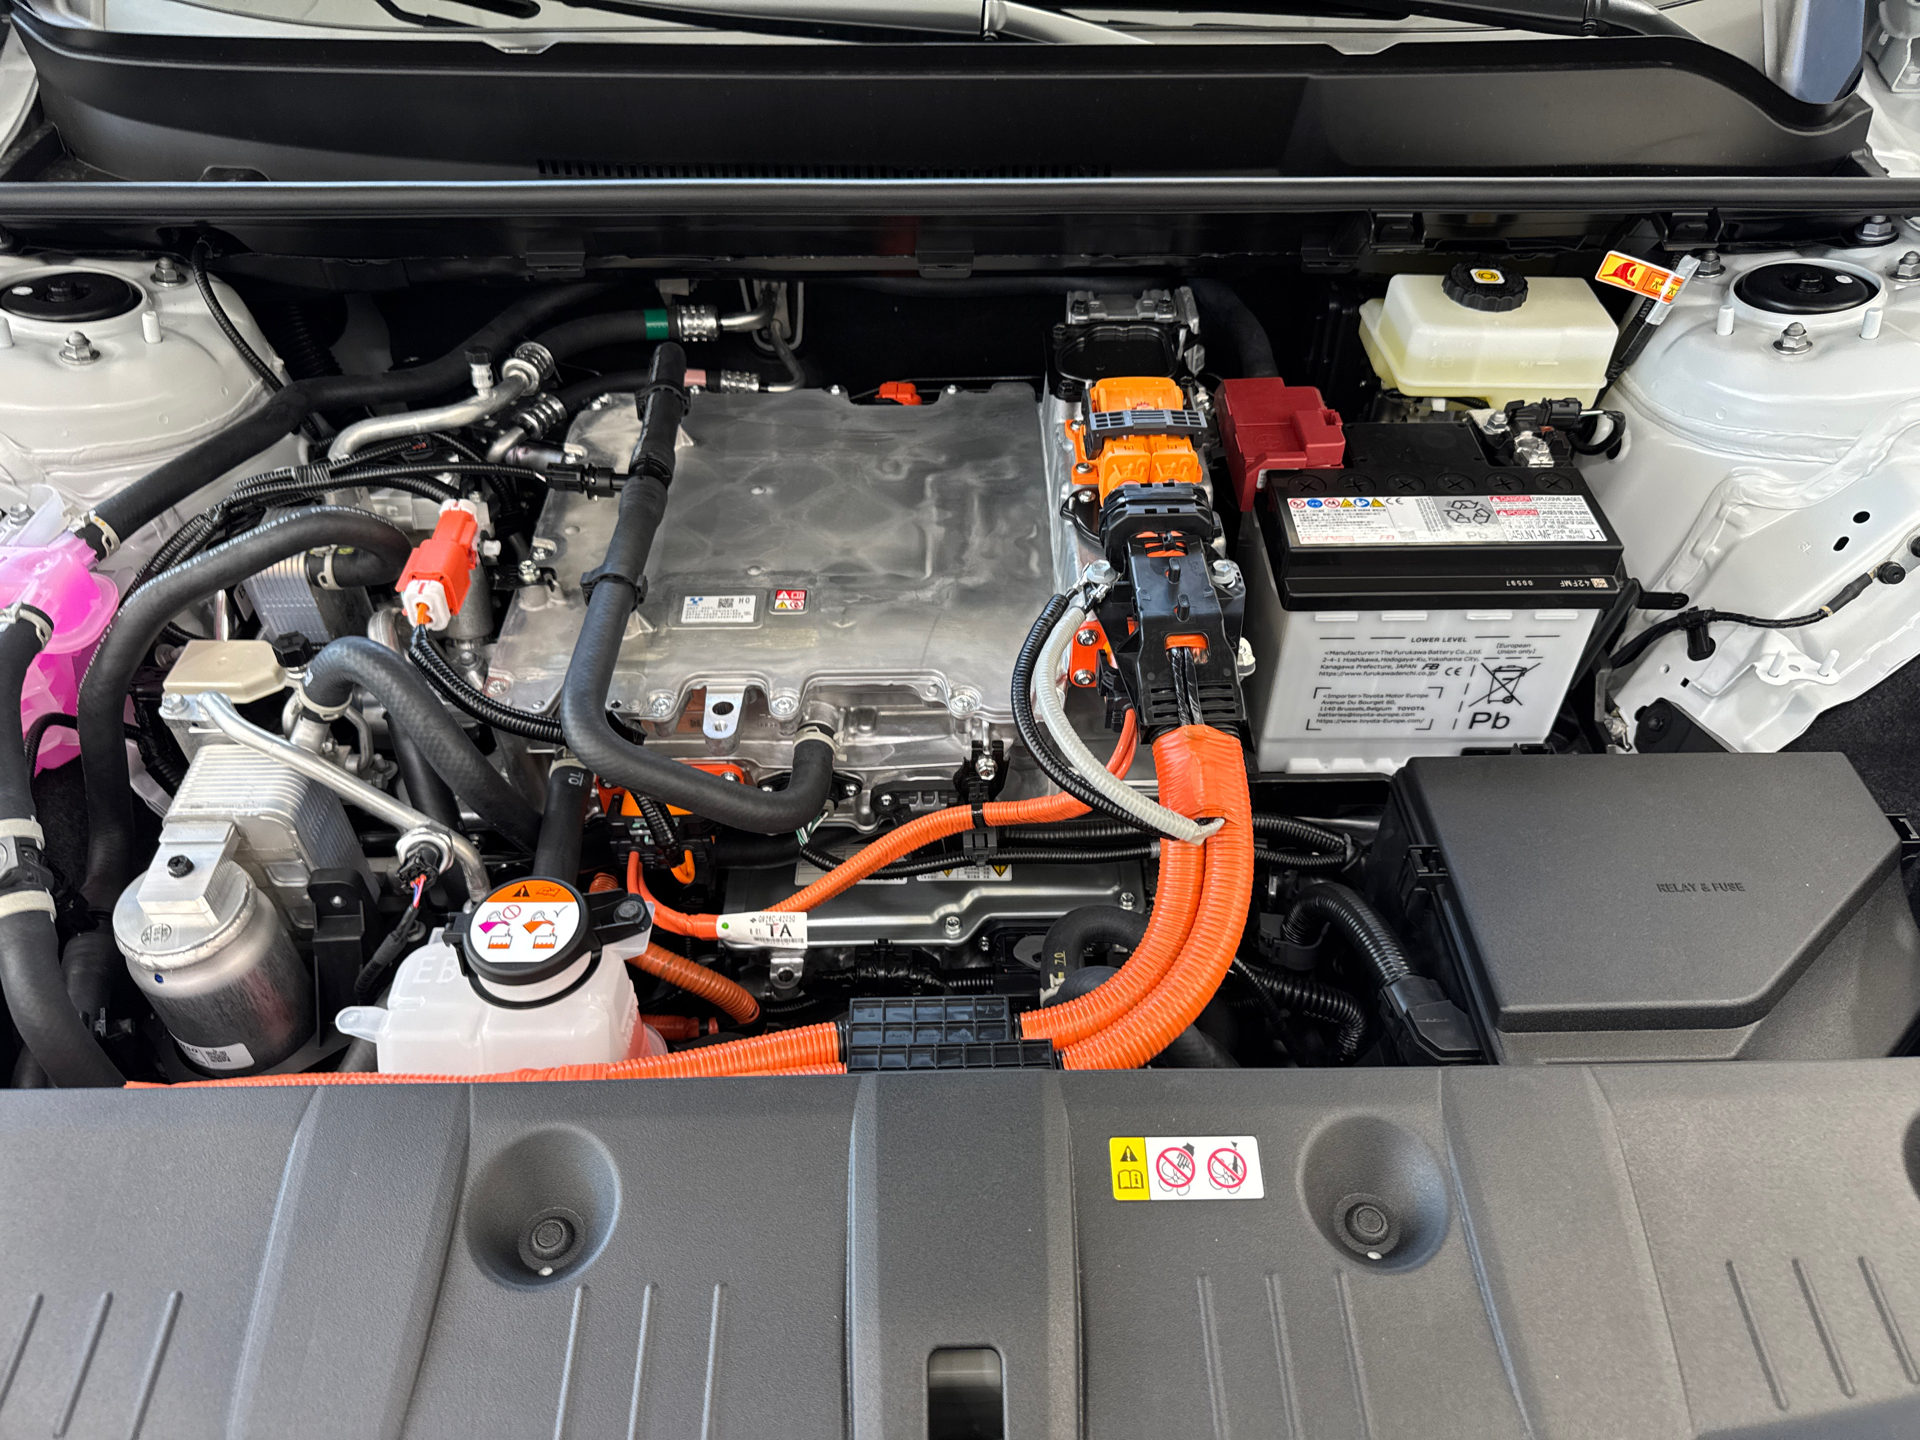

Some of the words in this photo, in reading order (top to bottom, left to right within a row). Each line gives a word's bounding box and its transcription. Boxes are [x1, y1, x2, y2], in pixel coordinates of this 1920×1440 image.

[1466, 531, 1488, 539] Pb
[1587, 530, 1604, 539] J1
[1468, 712, 1510, 729] Pb
[1656, 883, 1697, 893] RELAY
[1700, 883, 1711, 892] &
[1711, 882, 1745, 892] FUSE
[766, 923, 791, 937] TA
